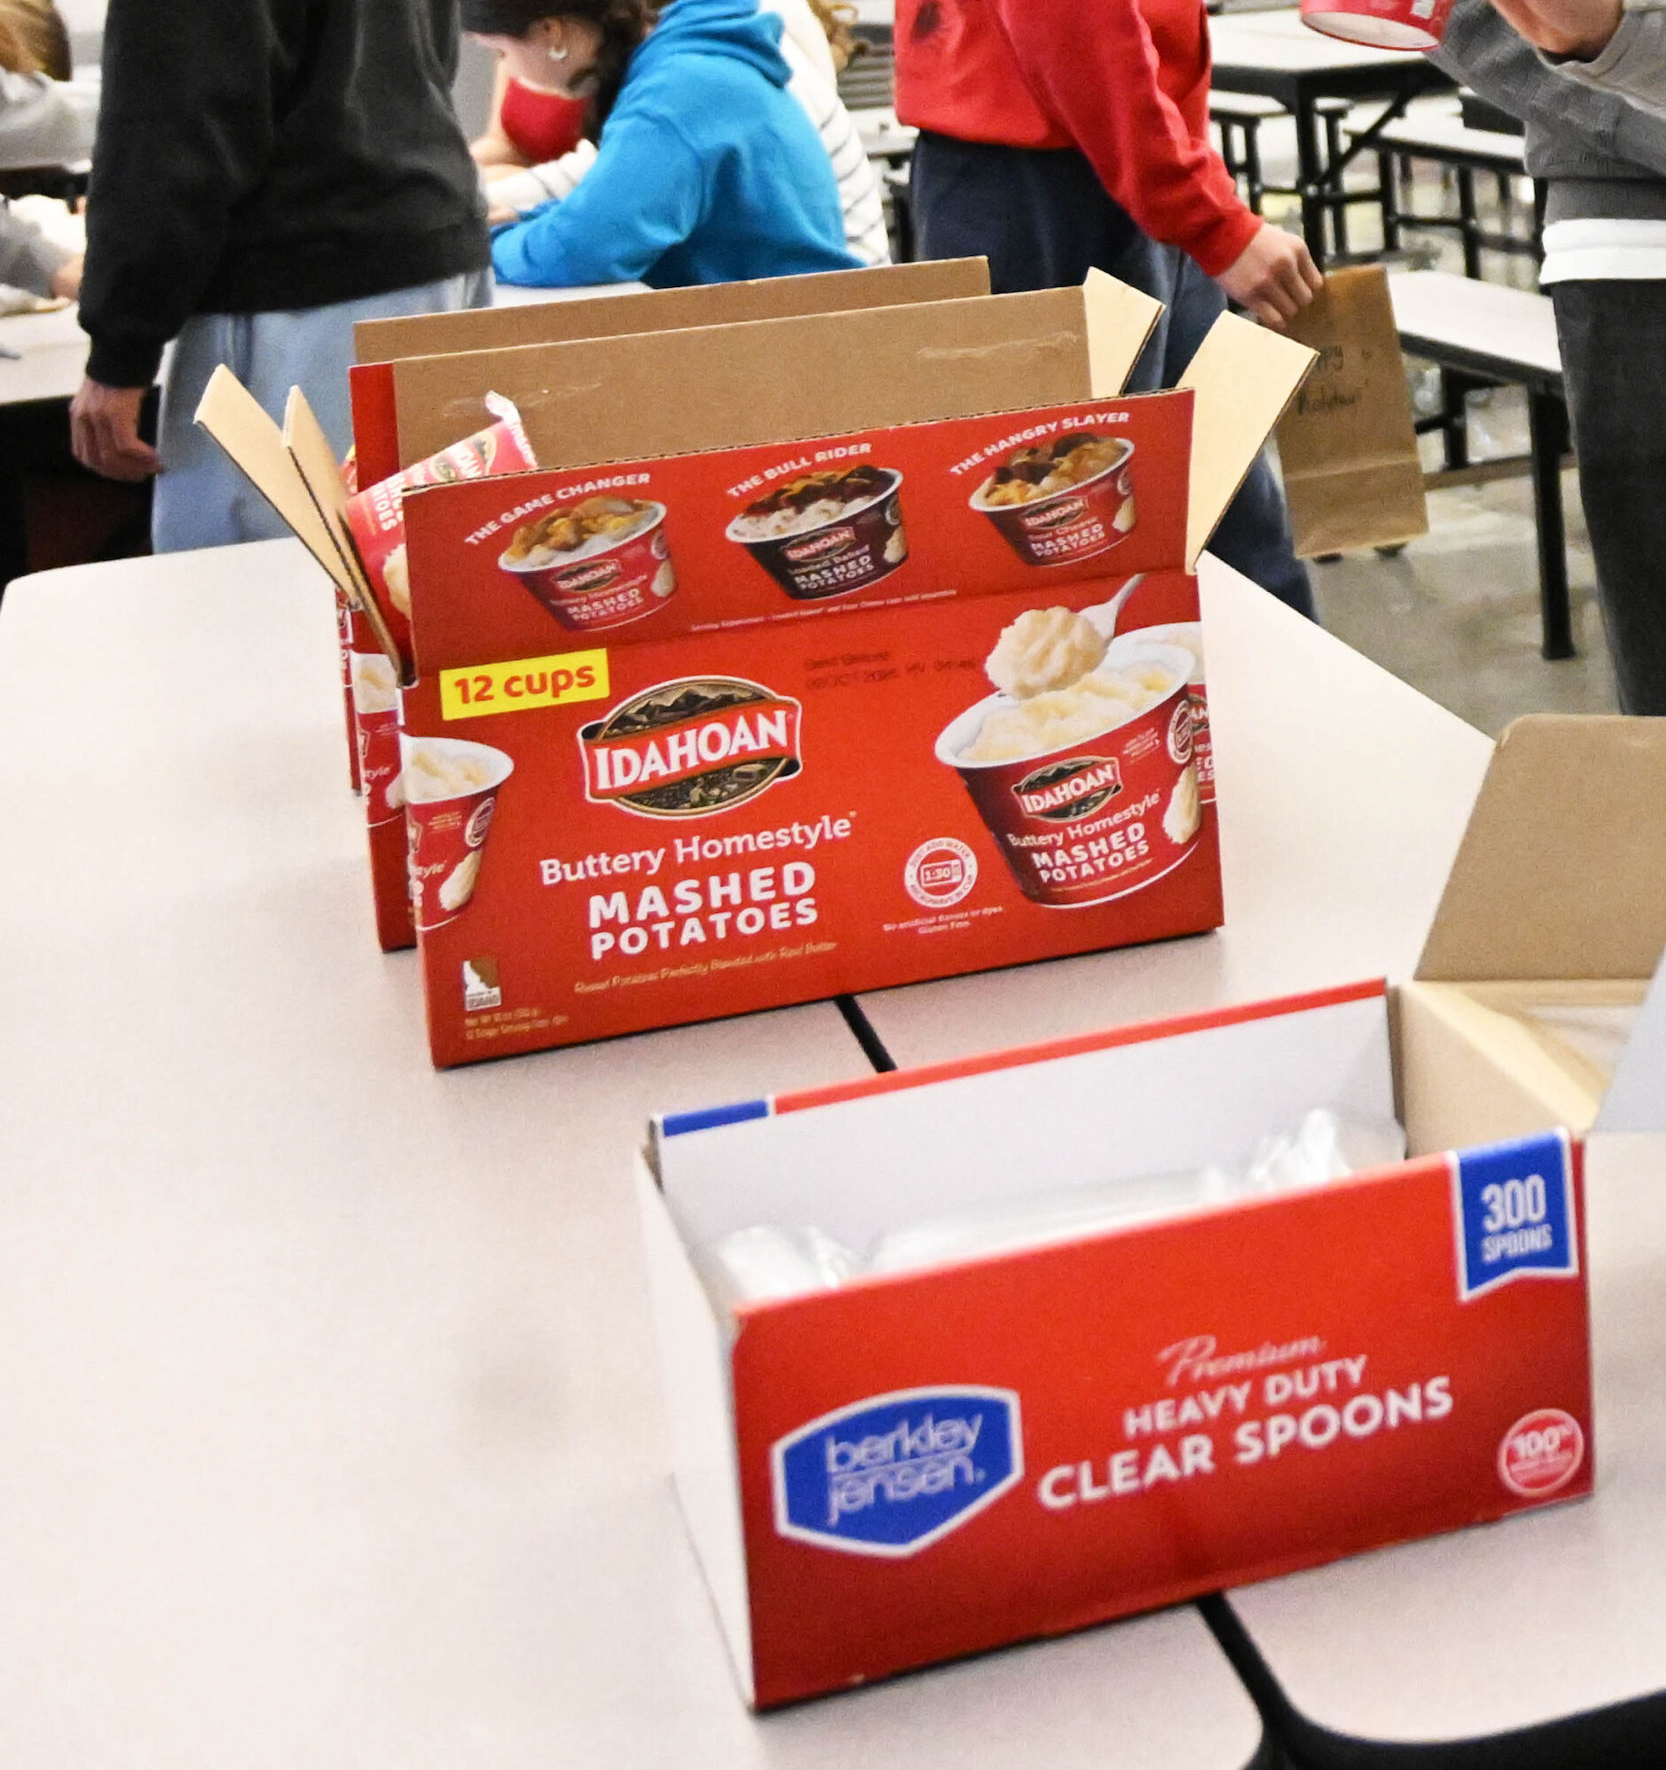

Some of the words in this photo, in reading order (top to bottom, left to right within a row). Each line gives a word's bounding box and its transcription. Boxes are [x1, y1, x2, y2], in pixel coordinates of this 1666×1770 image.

[950, 452, 986, 476] THE
[984, 420, 1059, 458] HANGRY
[1061, 411, 1130, 430] SLAYER
[727, 476, 764, 498] THE
[764, 456, 812, 480] BULL
[814, 442, 873, 463] RIDER
[464, 517, 501, 545] THE
[500, 493, 555, 523] GAME
[556, 473, 651, 500] CHANGER
[1023, 498, 1085, 527] IDAHOAN
[786, 528, 852, 560] IDAHOAN
[1030, 523, 1104, 551] MASHED
[1035, 531, 1106, 557] POTATOES
[557, 562, 617, 590] IDAHOAN
[794, 555, 872, 584] MASHED
[799, 564, 875, 590] POTATOES
[567, 588, 640, 615] MASHED
[572, 596, 644, 621] POTATOES
[455, 675, 494, 705] 12
[504, 665, 596, 699] cups
[595, 710, 788, 790] IDAHOAN
[1021, 764, 1115, 813] IDAHOAN
[1007, 831, 1064, 850] Buttery
[1066, 793, 1160, 840] Homestyle
[1031, 822, 1145, 869] MASHED
[540, 847, 666, 885] Buttery
[673, 814, 852, 864] Homestyle
[1038, 839, 1150, 883] POTATOES
[589, 861, 816, 928] MASHED
[591, 898, 818, 961] POTATOES
[1481, 1174, 1547, 1234] 300
[1481, 1223, 1553, 1265] SPOONS
[1156, 1333, 1328, 1388] Premium
[1122, 1380, 1252, 1440] HEAVY
[1264, 1353, 1368, 1407] DUTY
[825, 1412, 983, 1475] berkley
[1036, 1433, 1216, 1510] CLEAR
[1234, 1375, 1455, 1466] SPOONS
